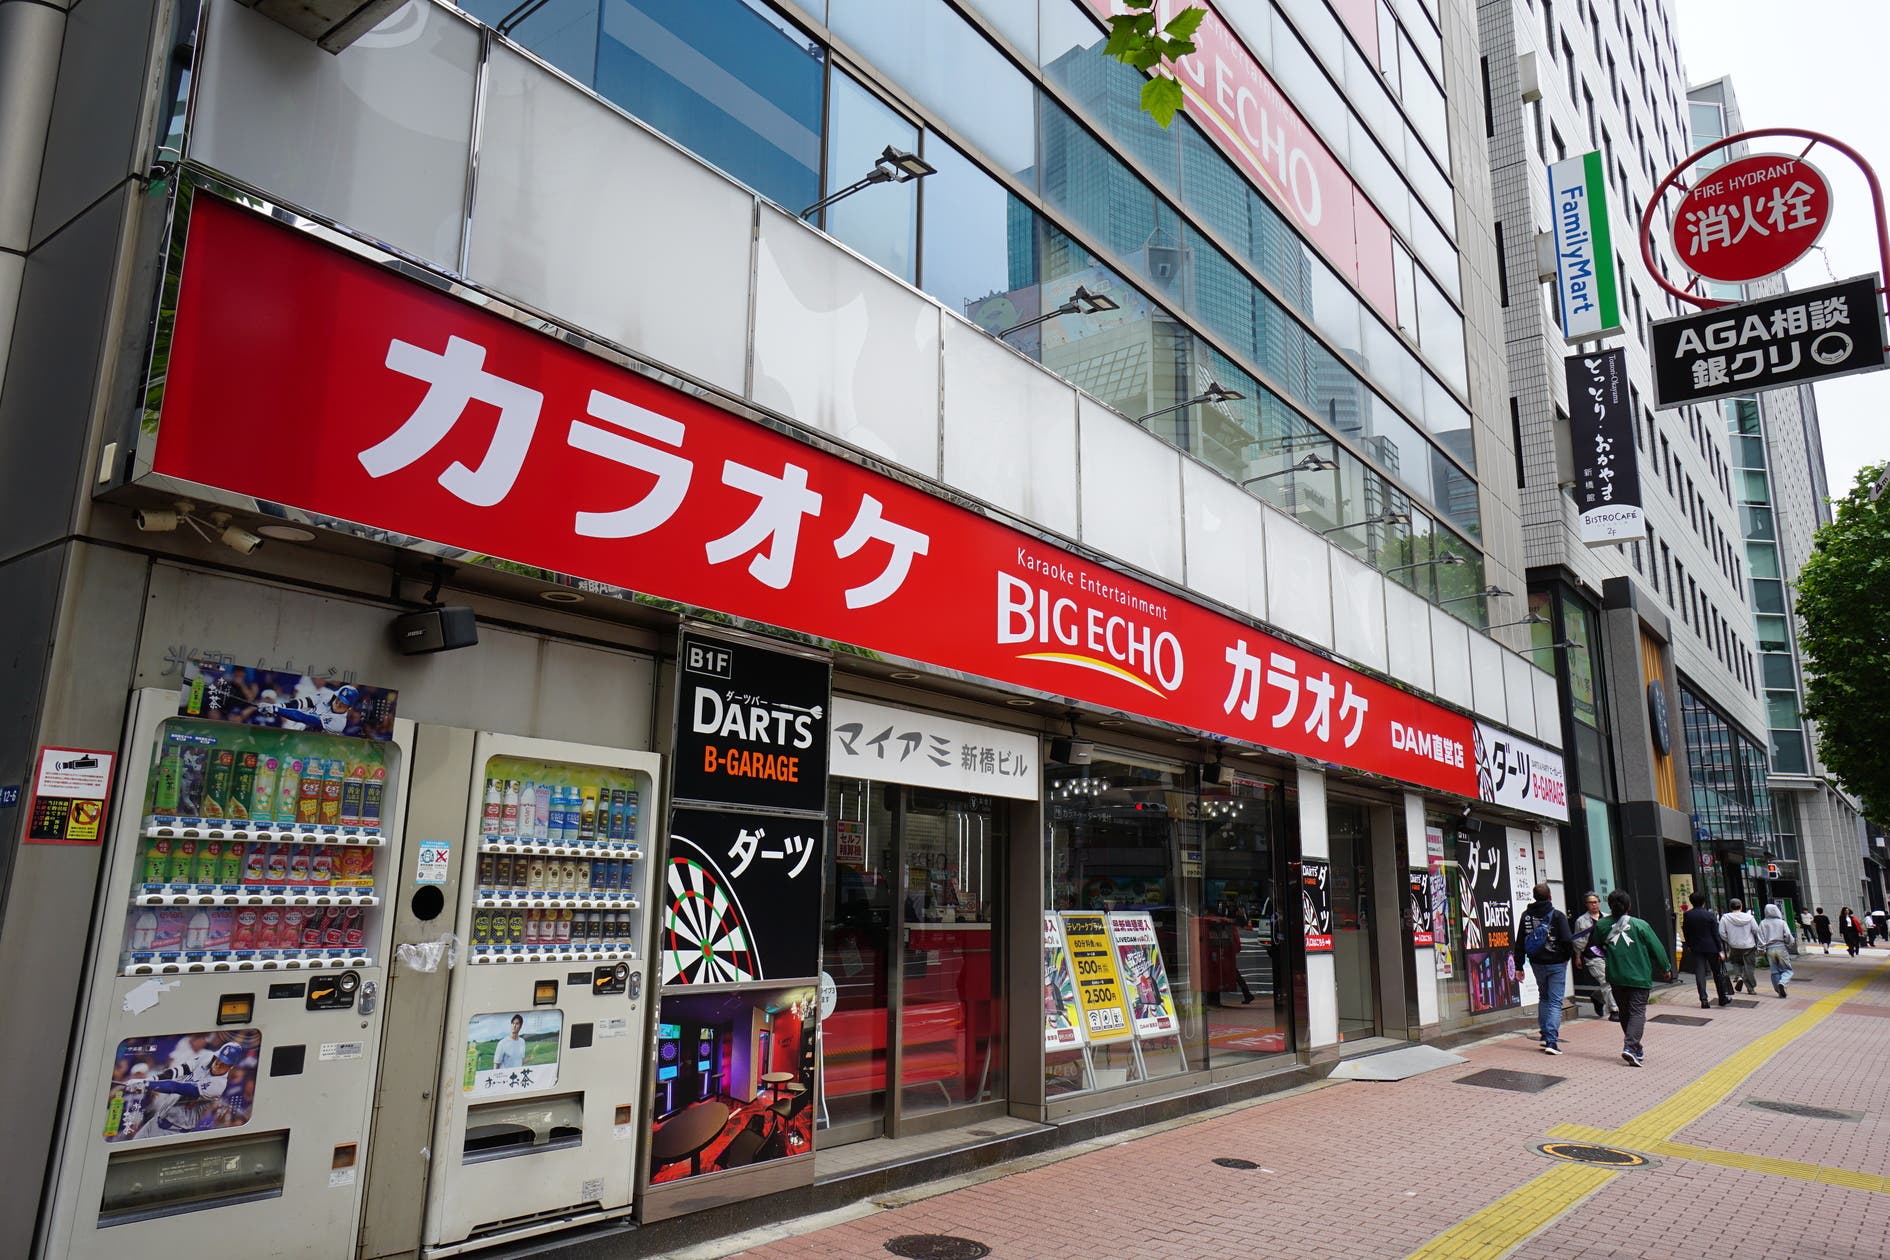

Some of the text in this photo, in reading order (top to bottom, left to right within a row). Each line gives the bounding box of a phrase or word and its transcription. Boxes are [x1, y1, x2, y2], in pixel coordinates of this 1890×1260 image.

[1215, 54, 1322, 227] ECHO
[1693, 160, 1796, 201] FIRE HYDRANT
[1685, 180, 1817, 256] 消火栓
[1561, 185, 1594, 315] FamilyMart
[1674, 296, 1850, 359] AGA相談
[357, 334, 930, 610] カラオケ
[1017, 547, 1168, 621] Karaoke Entertainment
[997, 570, 1184, 691] BIG ECHO
[690, 648, 729, 672] B1F
[692, 686, 813, 750] DARTS
[725, 690, 769, 707] ダーツバー
[1223, 639, 1369, 749] カラオケ
[704, 745, 799, 783] B-GARAGE
[834, 722, 1028, 777] マイアミ 新橋ビル
[1390, 720, 1465, 769] DAM直営店
[1493, 741, 1530, 799] ダーツ
[1533, 773, 1565, 807] B-GARAGE
[728, 828, 815, 879] ダーツ
[839, 834, 862, 844] セルフ
[1467, 839, 1500, 890] ダーツ
[1318, 866, 1329, 933] ダーツ
[1421, 874, 1431, 931] ダーツ
[1483, 901, 1510, 927] DARTS
